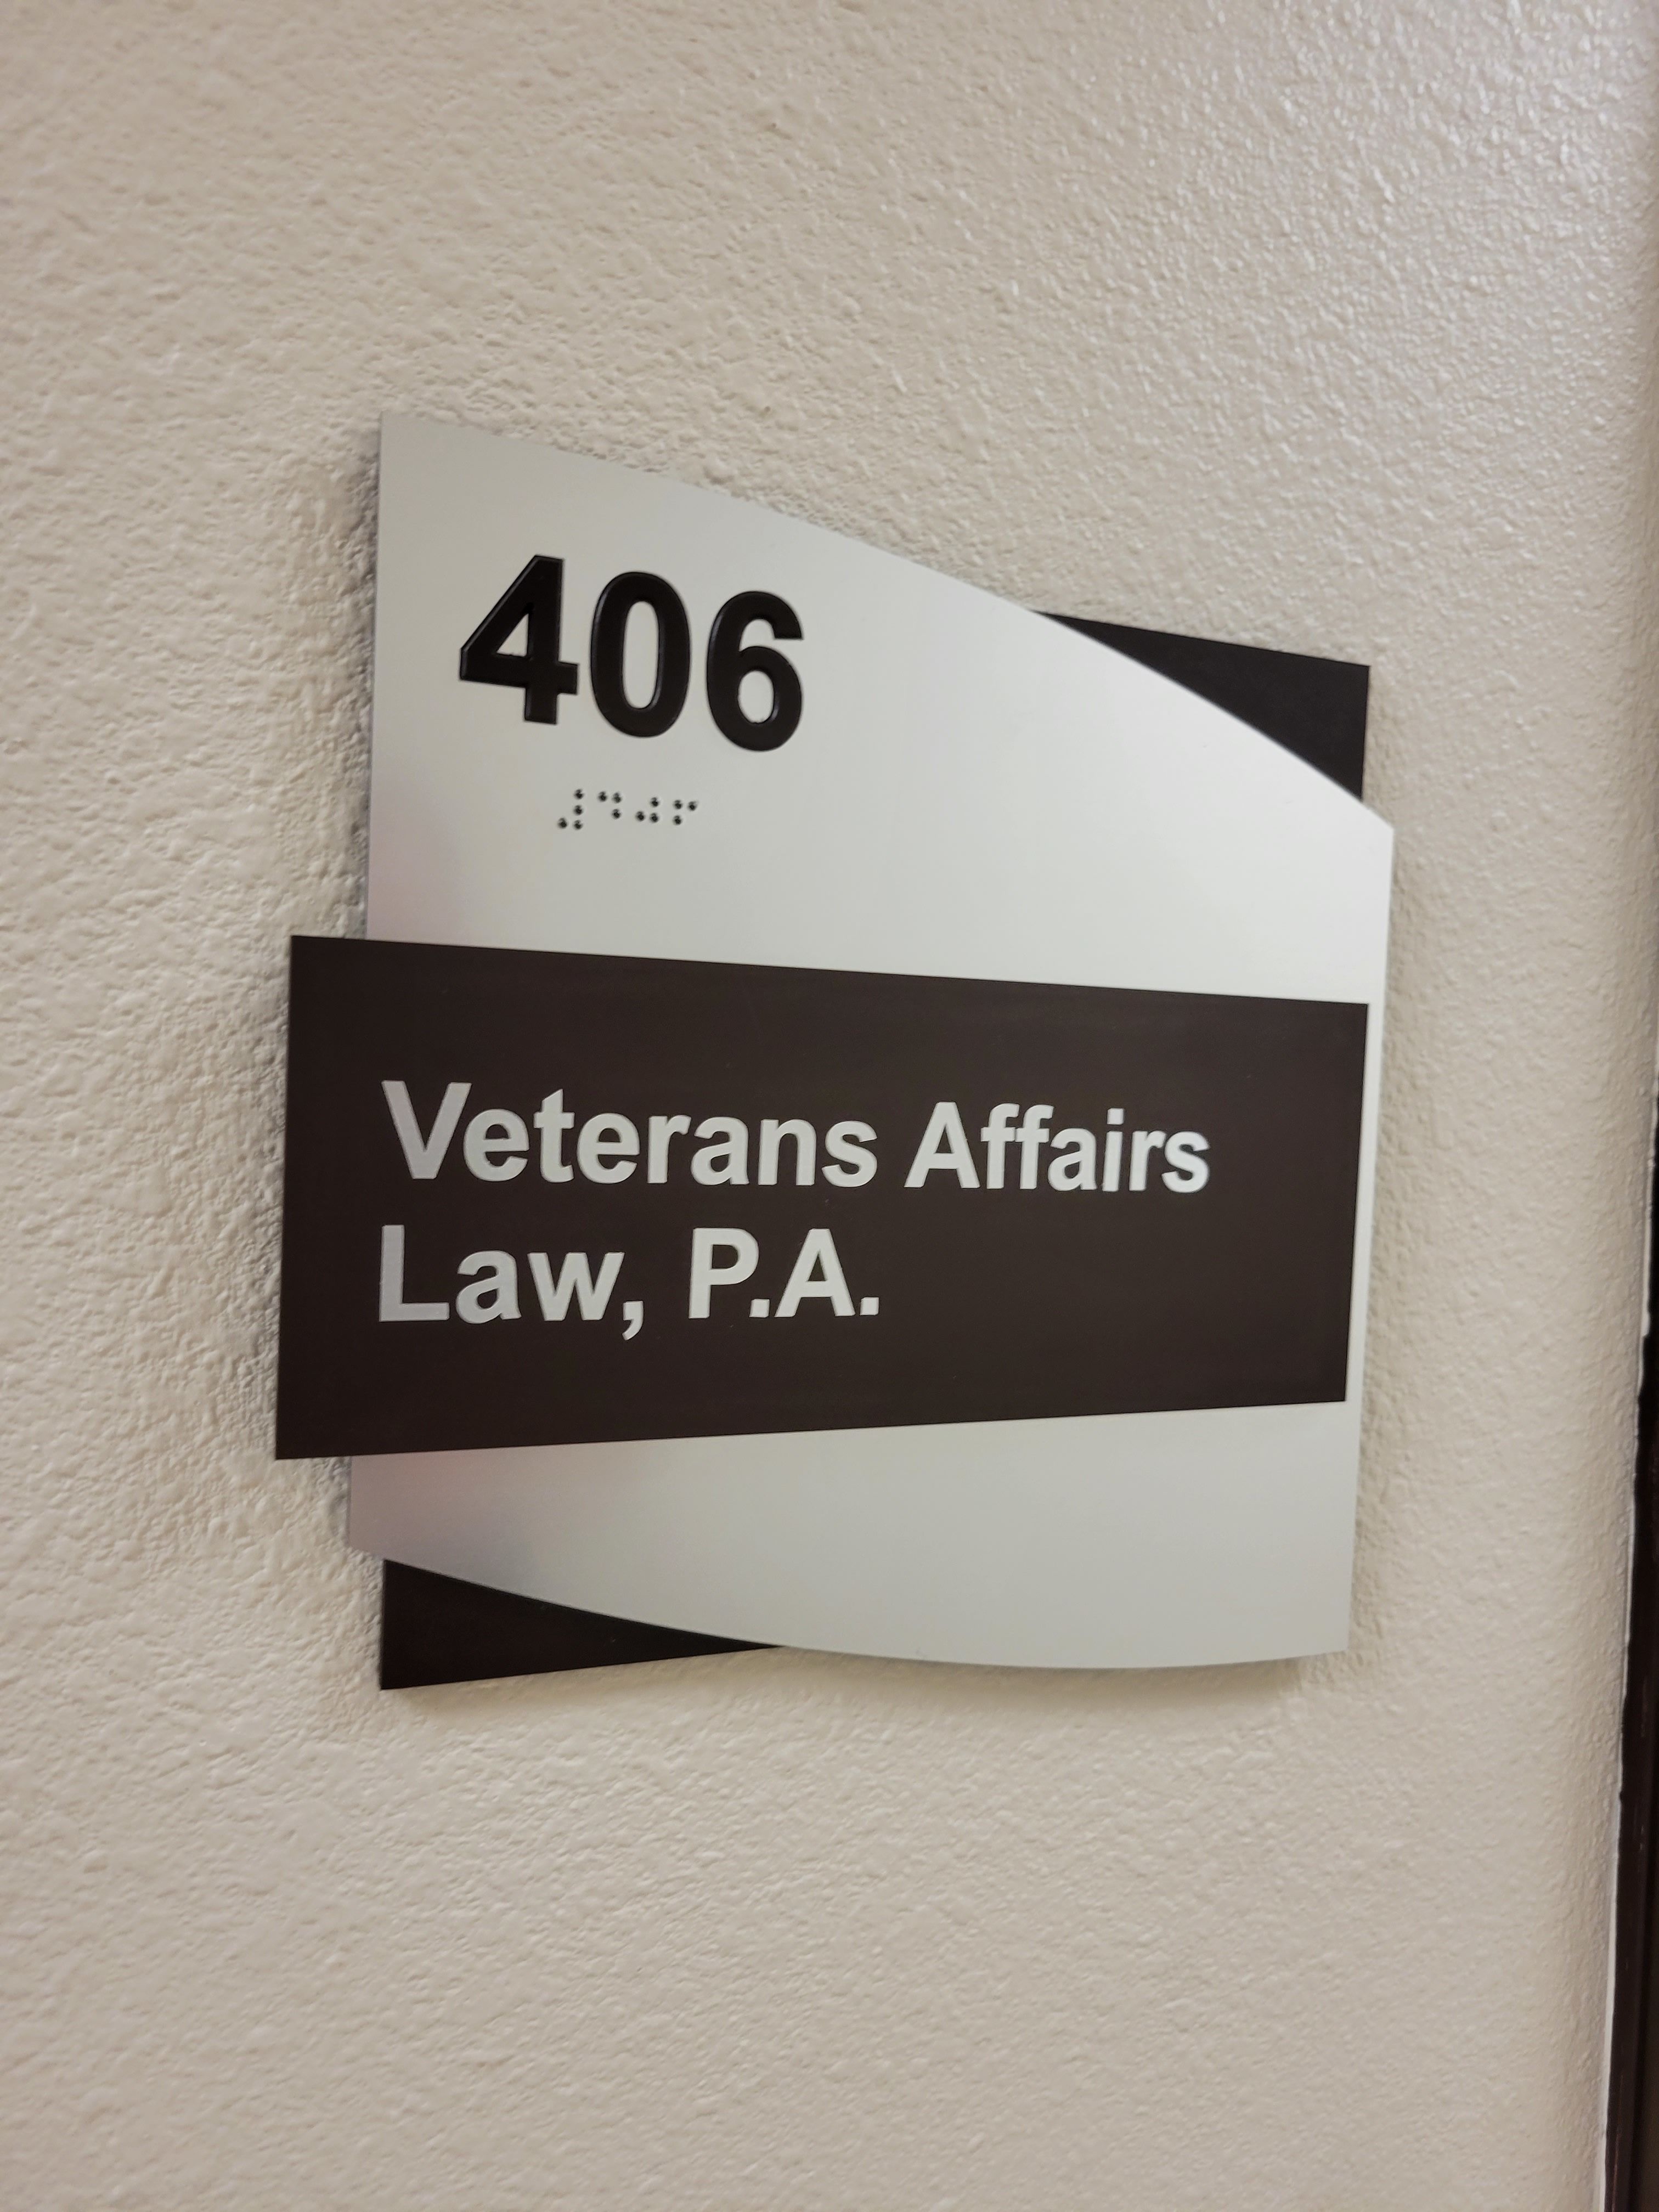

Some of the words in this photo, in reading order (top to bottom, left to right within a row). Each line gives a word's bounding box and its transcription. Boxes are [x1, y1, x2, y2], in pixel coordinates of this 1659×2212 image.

[458, 554, 804, 753] 406
[382, 1080, 878, 1188] Veterans
[904, 1101, 1210, 1193] Affairs
[380, 1224, 644, 1340] Law,
[689, 1227, 879, 1319] P.A.
